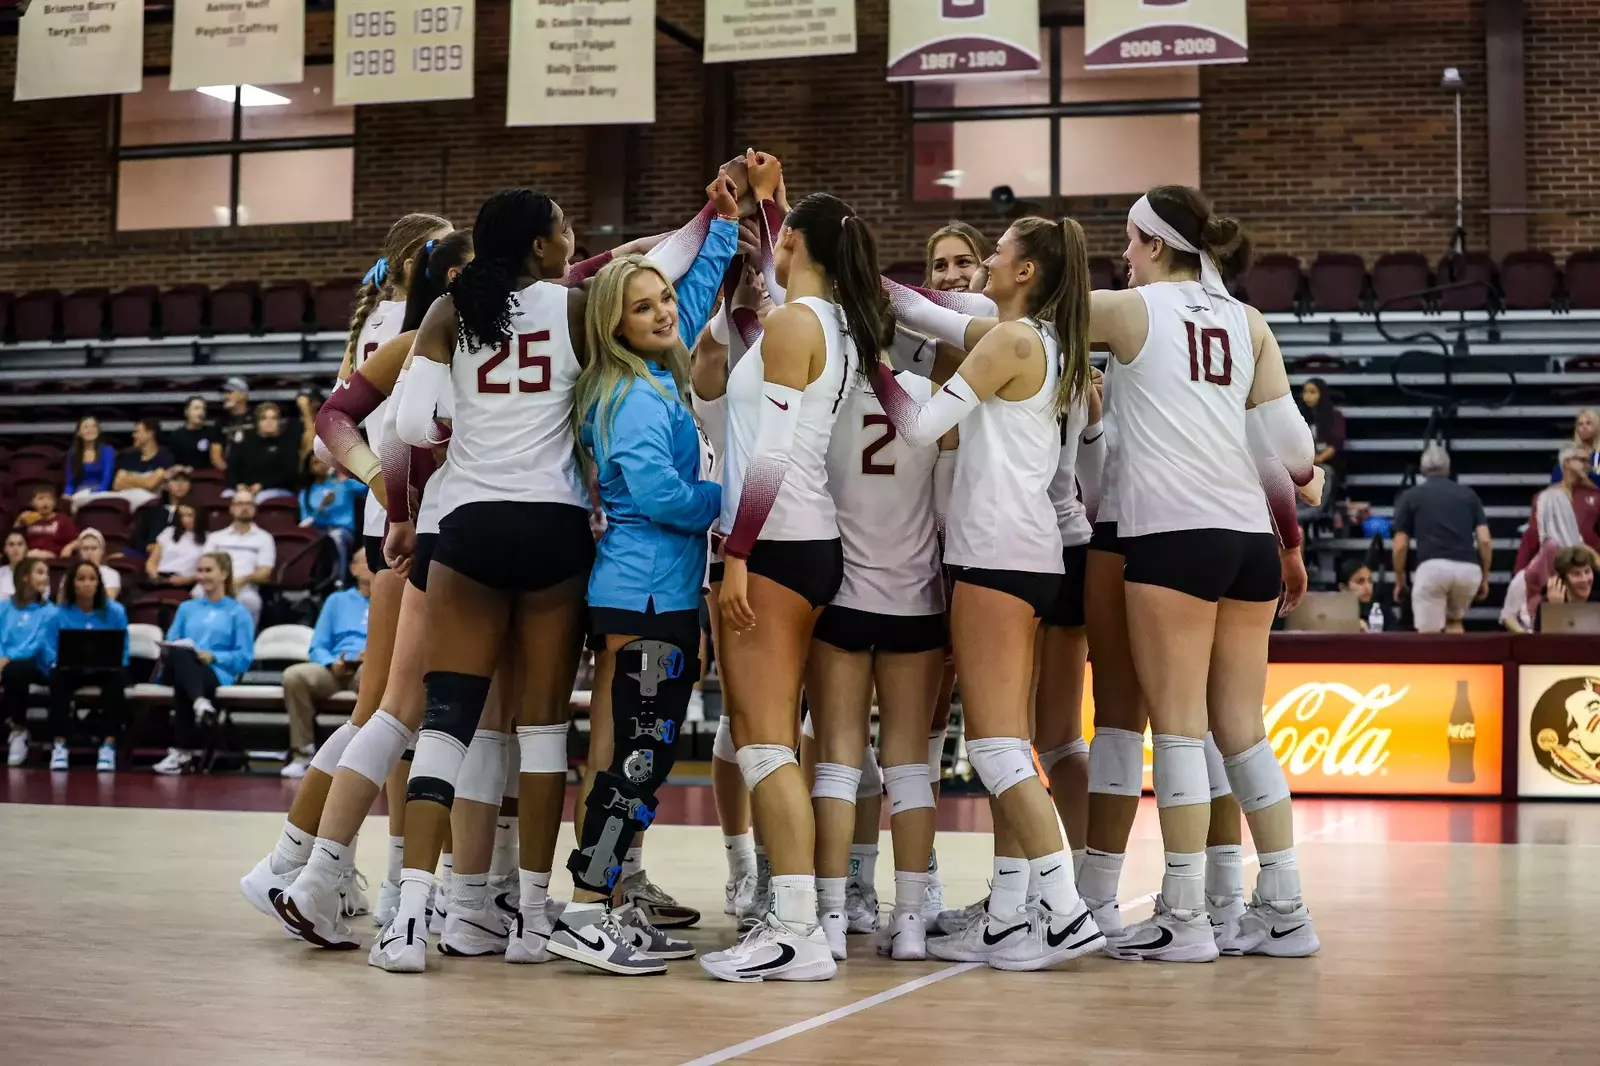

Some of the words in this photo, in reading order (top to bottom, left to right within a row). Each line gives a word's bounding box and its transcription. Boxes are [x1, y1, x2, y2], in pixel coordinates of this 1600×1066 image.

[347, 10, 397, 38] 1986
[413, 5, 463, 34] 1987
[346, 49, 396, 77] 1988
[412, 44, 463, 73] 1989
[477, 329, 552, 394] 25
[1183, 320, 1233, 386] 10
[861, 413, 897, 475] 2
[1262, 681, 1412, 777] Cola
